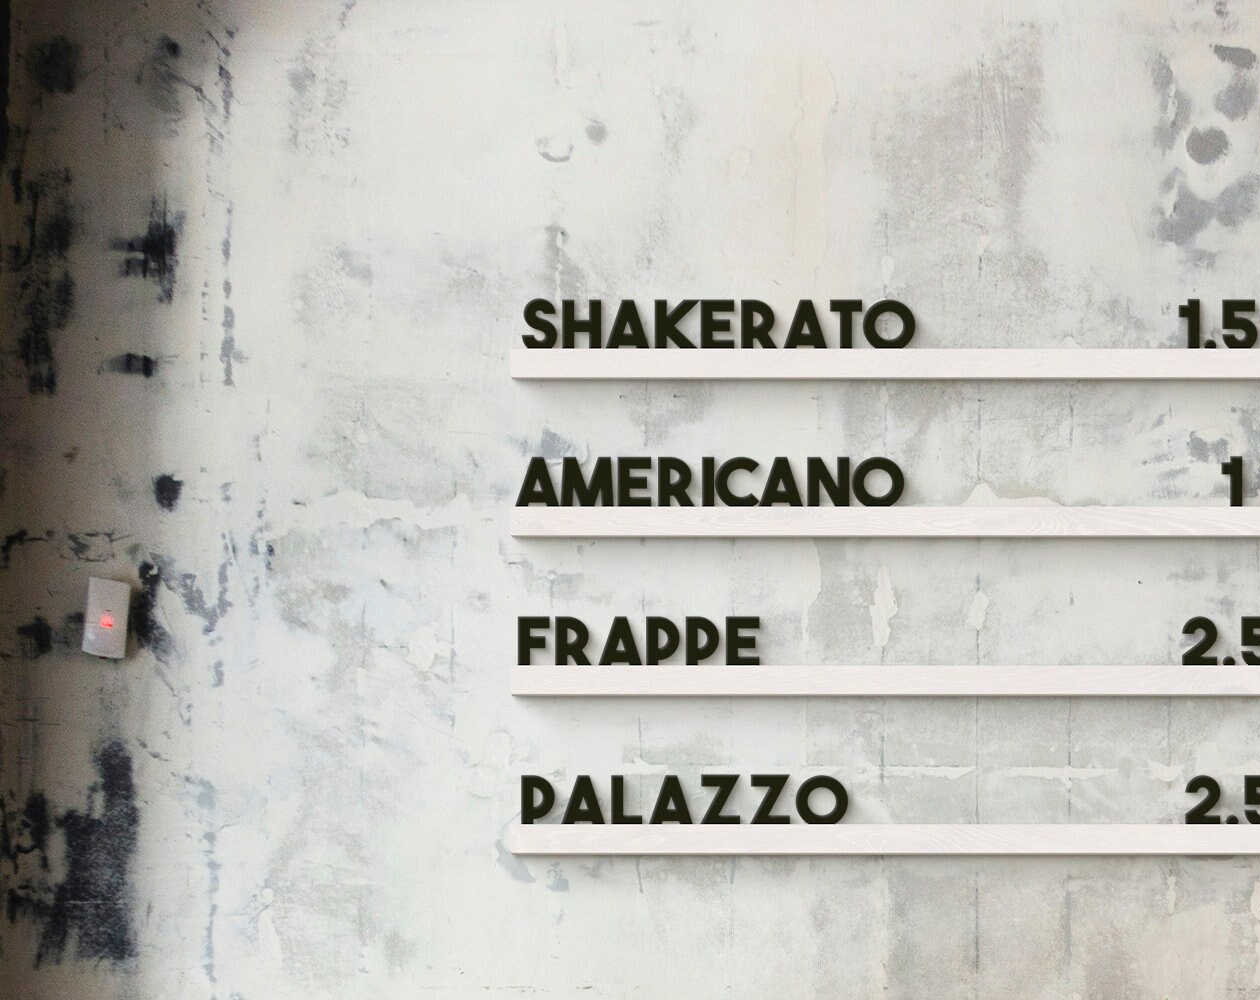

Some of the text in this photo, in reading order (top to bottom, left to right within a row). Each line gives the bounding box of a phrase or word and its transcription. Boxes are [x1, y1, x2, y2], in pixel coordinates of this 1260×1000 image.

[523, 299, 1258, 349] SHAKERATO 1.5
[516, 457, 1243, 507] AMERICANO 1
[517, 616, 761, 666] FRAPPE
[522, 775, 849, 825] PALAZZO
